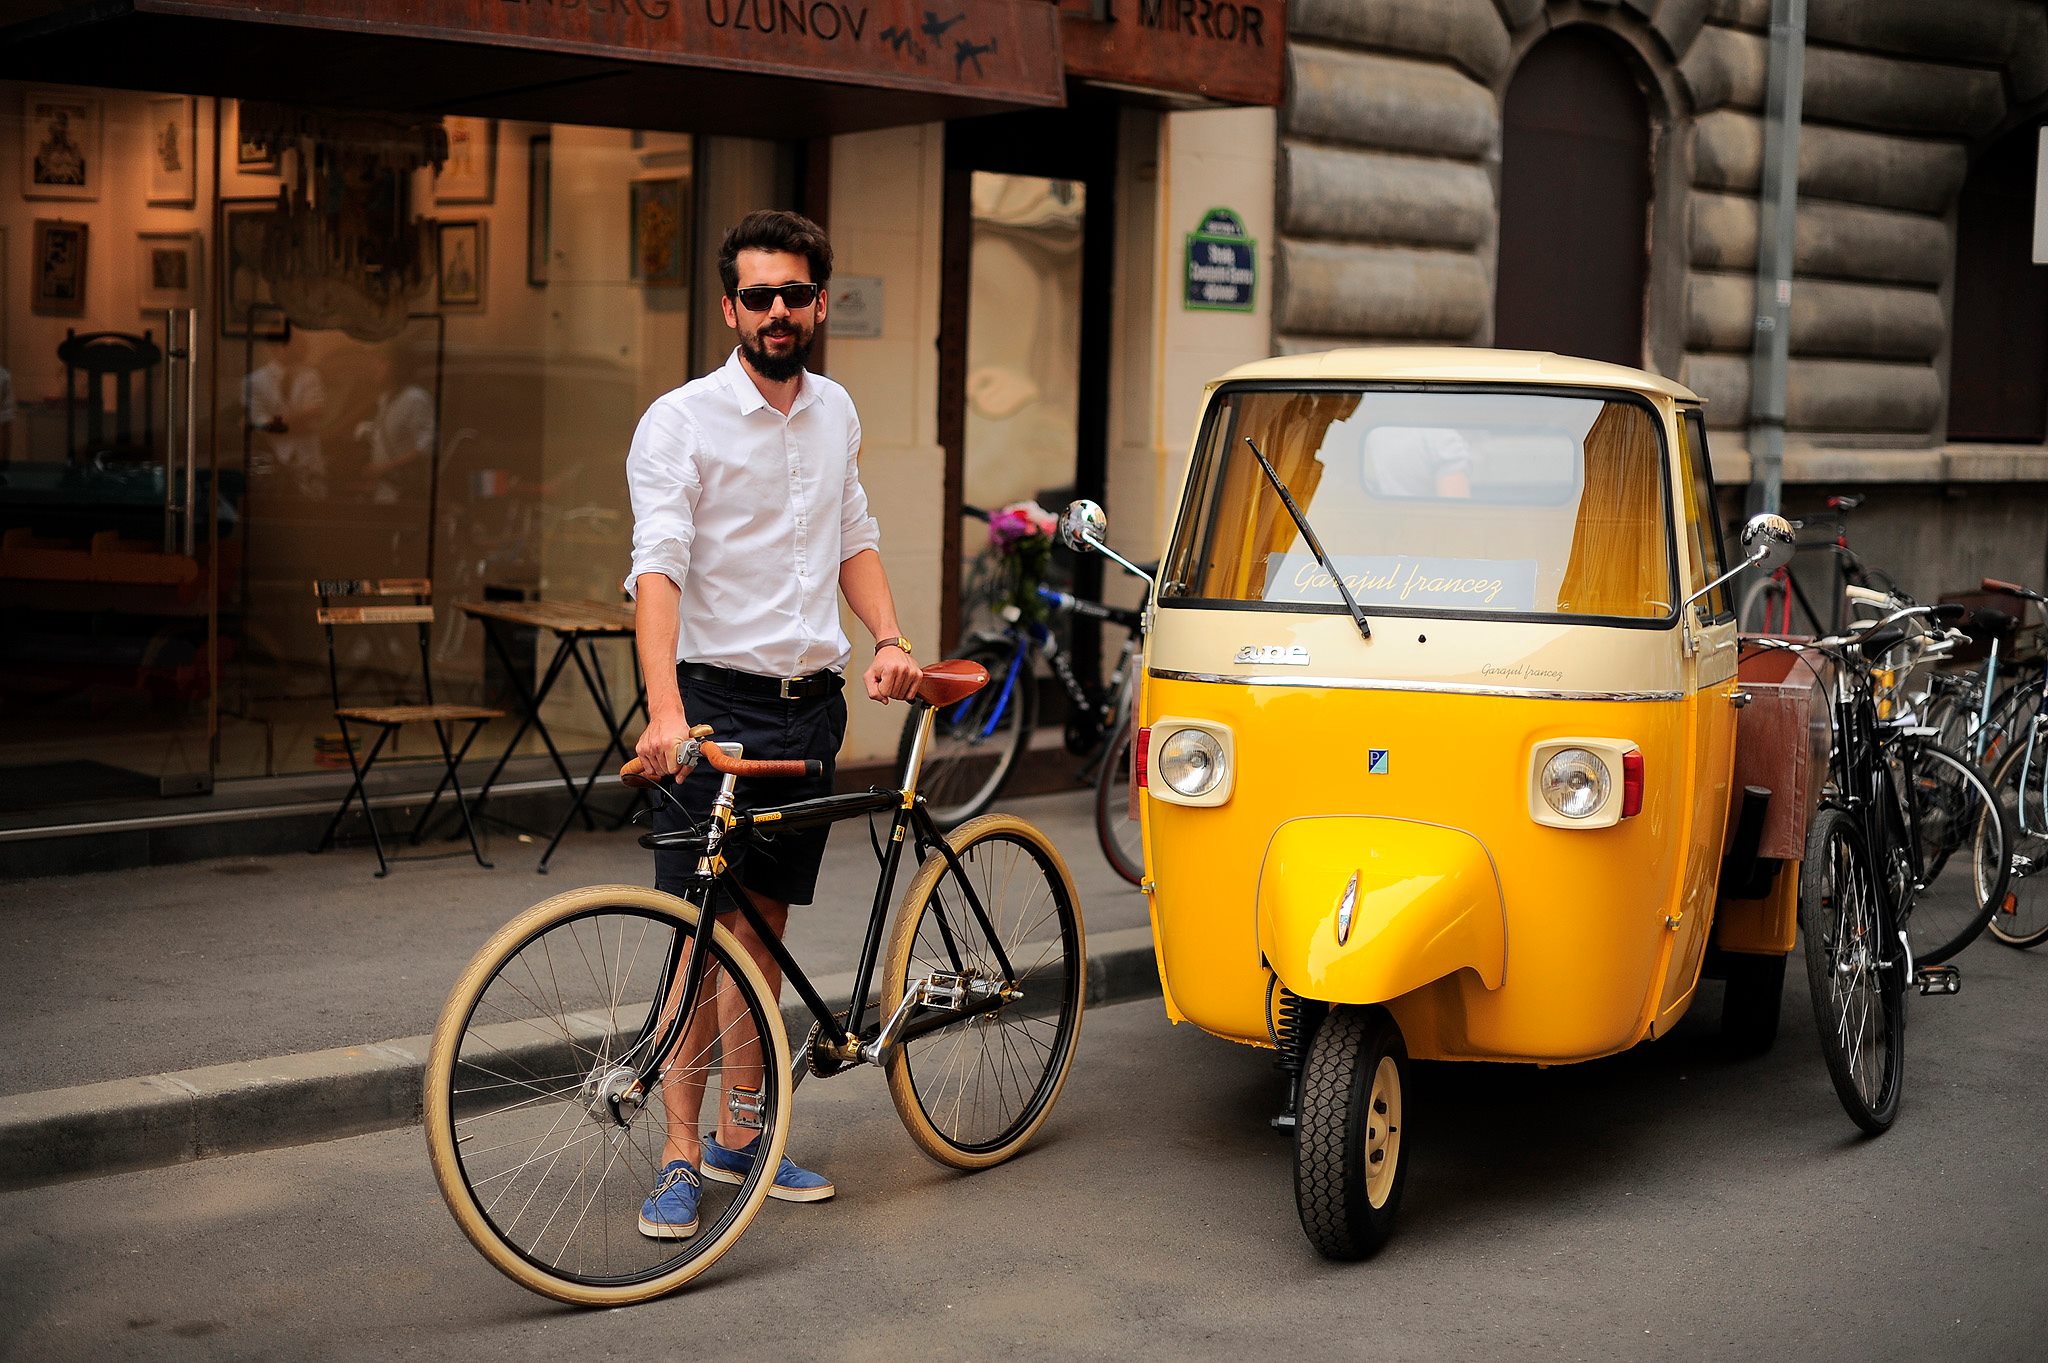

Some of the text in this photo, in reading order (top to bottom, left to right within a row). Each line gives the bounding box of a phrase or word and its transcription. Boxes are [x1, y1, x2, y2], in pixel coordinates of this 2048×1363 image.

[706, 0, 867, 41] UZUNOV
[1137, 0, 1265, 47] MIRROR
[1399, 563, 1504, 603] francez
[1523, 664, 1564, 681] francez
